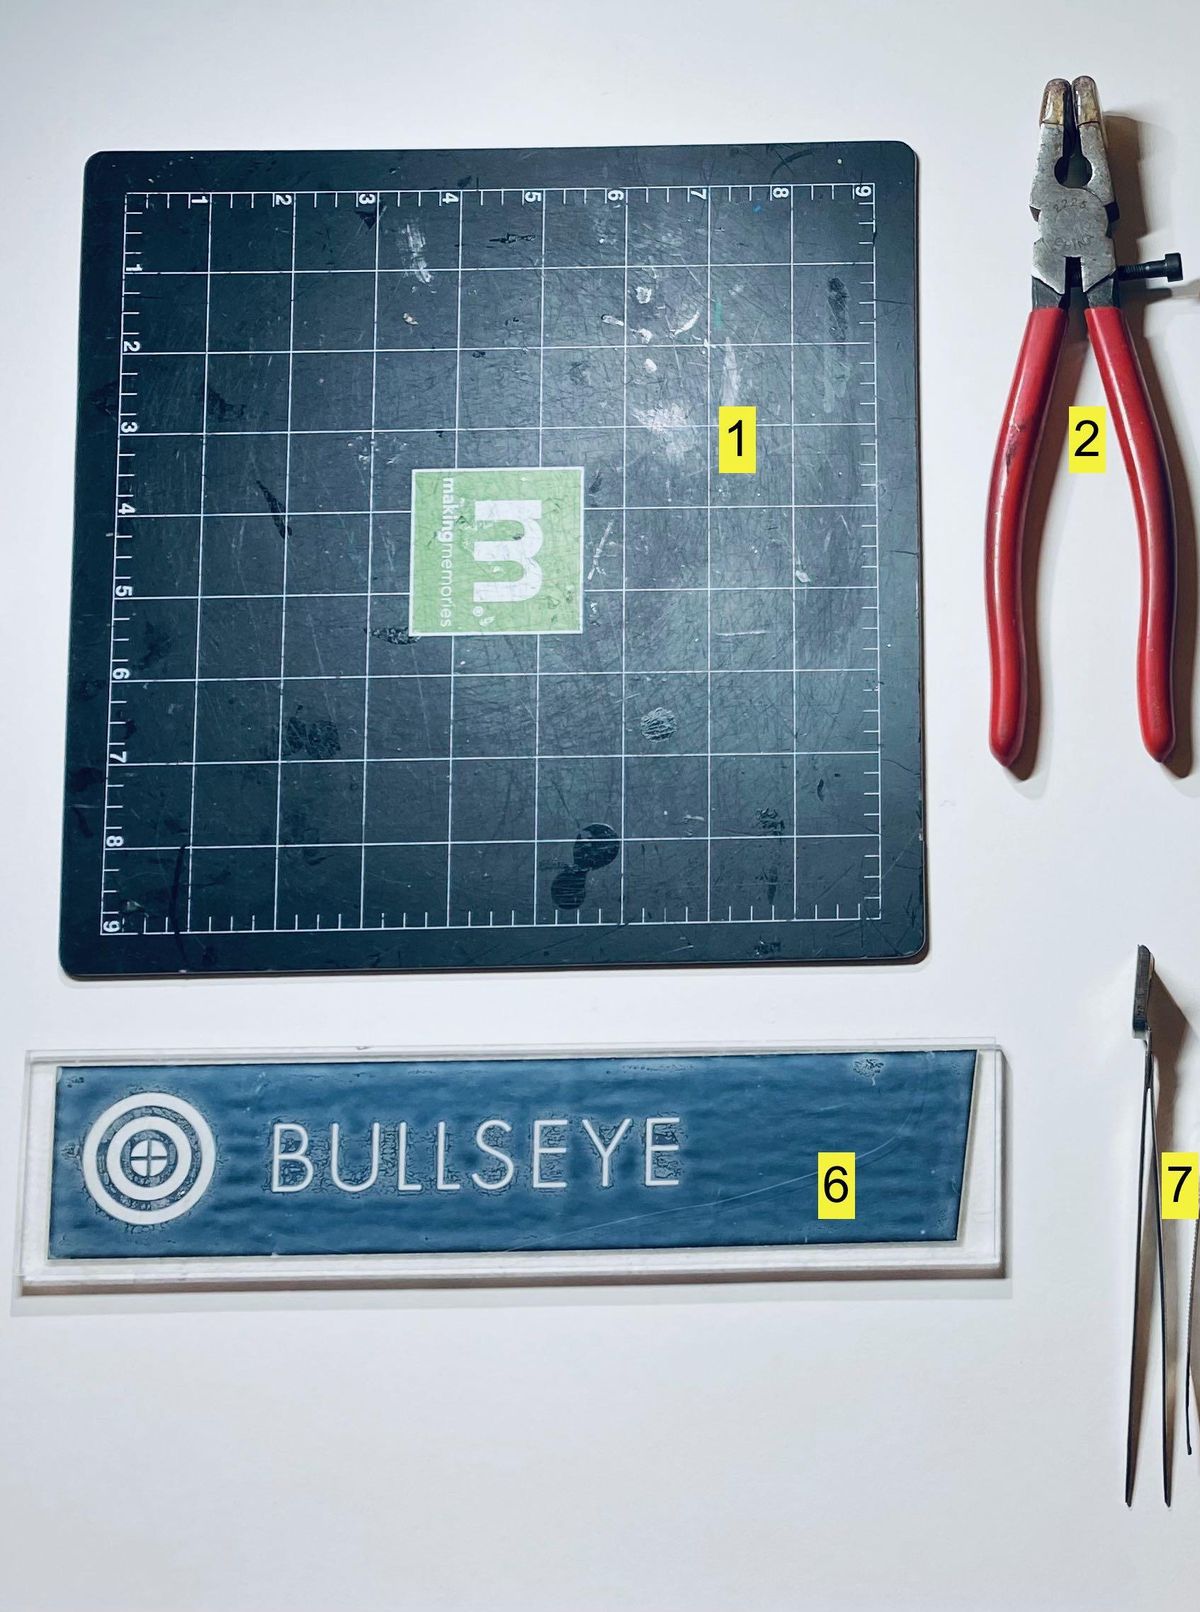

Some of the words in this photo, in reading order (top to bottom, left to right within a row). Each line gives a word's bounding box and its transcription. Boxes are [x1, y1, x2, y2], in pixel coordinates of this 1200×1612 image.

[191, 195, 208, 204] 1
[275, 194, 292, 206] 2
[358, 193, 376, 205] 3
[442, 192, 459, 204] 4
[525, 191, 541, 202] 5
[607, 190, 624, 201] 6
[691, 188, 707, 200] 7
[773, 187, 789, 198] 8
[855, 185, 872, 197] 9
[125, 264, 142, 272] 1
[123, 341, 141, 352] 2
[120, 422, 138, 433] 3
[118, 503, 135, 514] 4
[115, 585, 132, 597] 5
[112, 667, 130, 679] 6
[109, 751, 127, 763] 7
[106, 835, 124, 847] 8
[103, 920, 120, 932] 9
[271, 1116, 680, 1193] BULLSEYE
